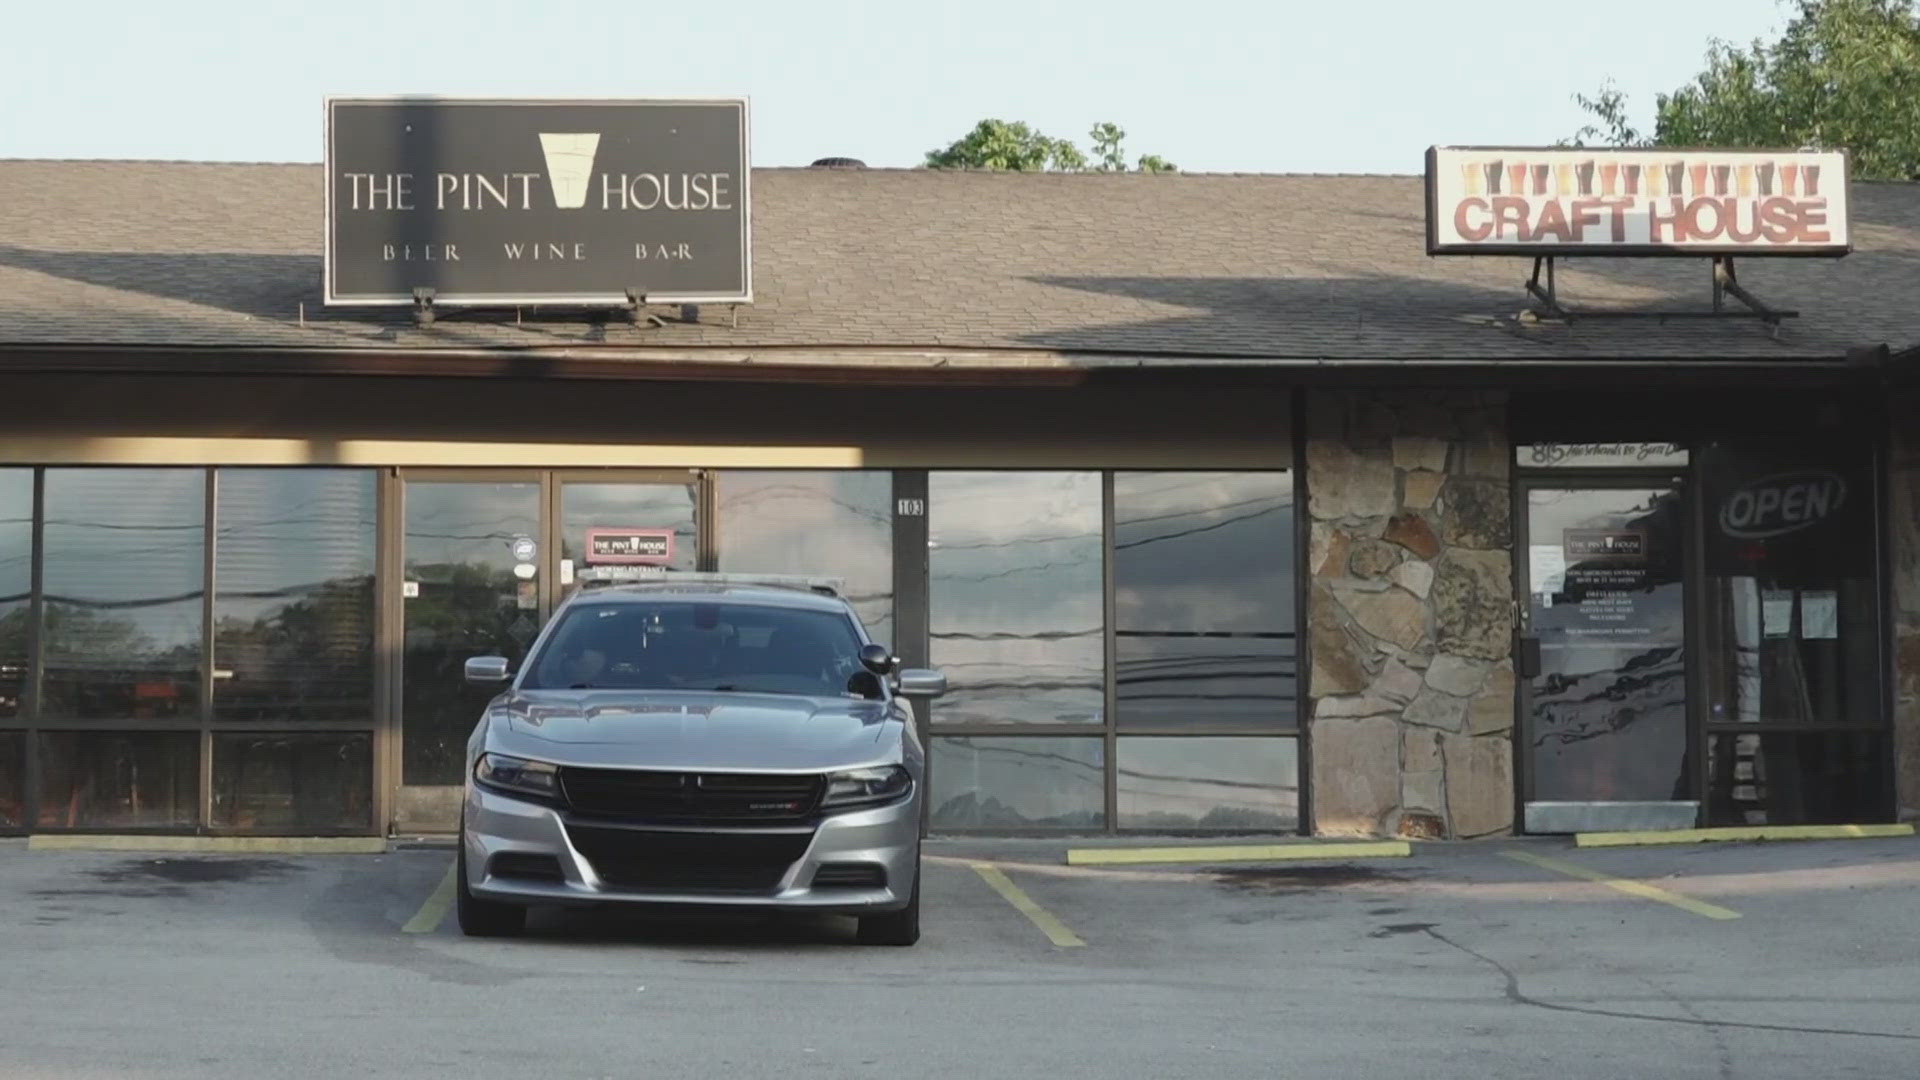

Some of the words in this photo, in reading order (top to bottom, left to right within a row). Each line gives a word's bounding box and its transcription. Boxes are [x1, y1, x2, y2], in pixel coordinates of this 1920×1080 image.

[344, 173, 415, 210] THE
[437, 173, 540, 210] PINT
[602, 173, 732, 210] HOUSE
[1454, 196, 1635, 241] CRAFT
[1649, 196, 1831, 242] HOUSE
[383, 244, 460, 261] BEER
[504, 243, 586, 260] WINE
[635, 243, 692, 260] BAR
[901, 500, 922, 514] 103
[1728, 481, 1832, 527] OPEN
[594, 541, 609, 549] THE
[612, 541, 630, 549] PINT
[640, 541, 666, 549] HOUSE
